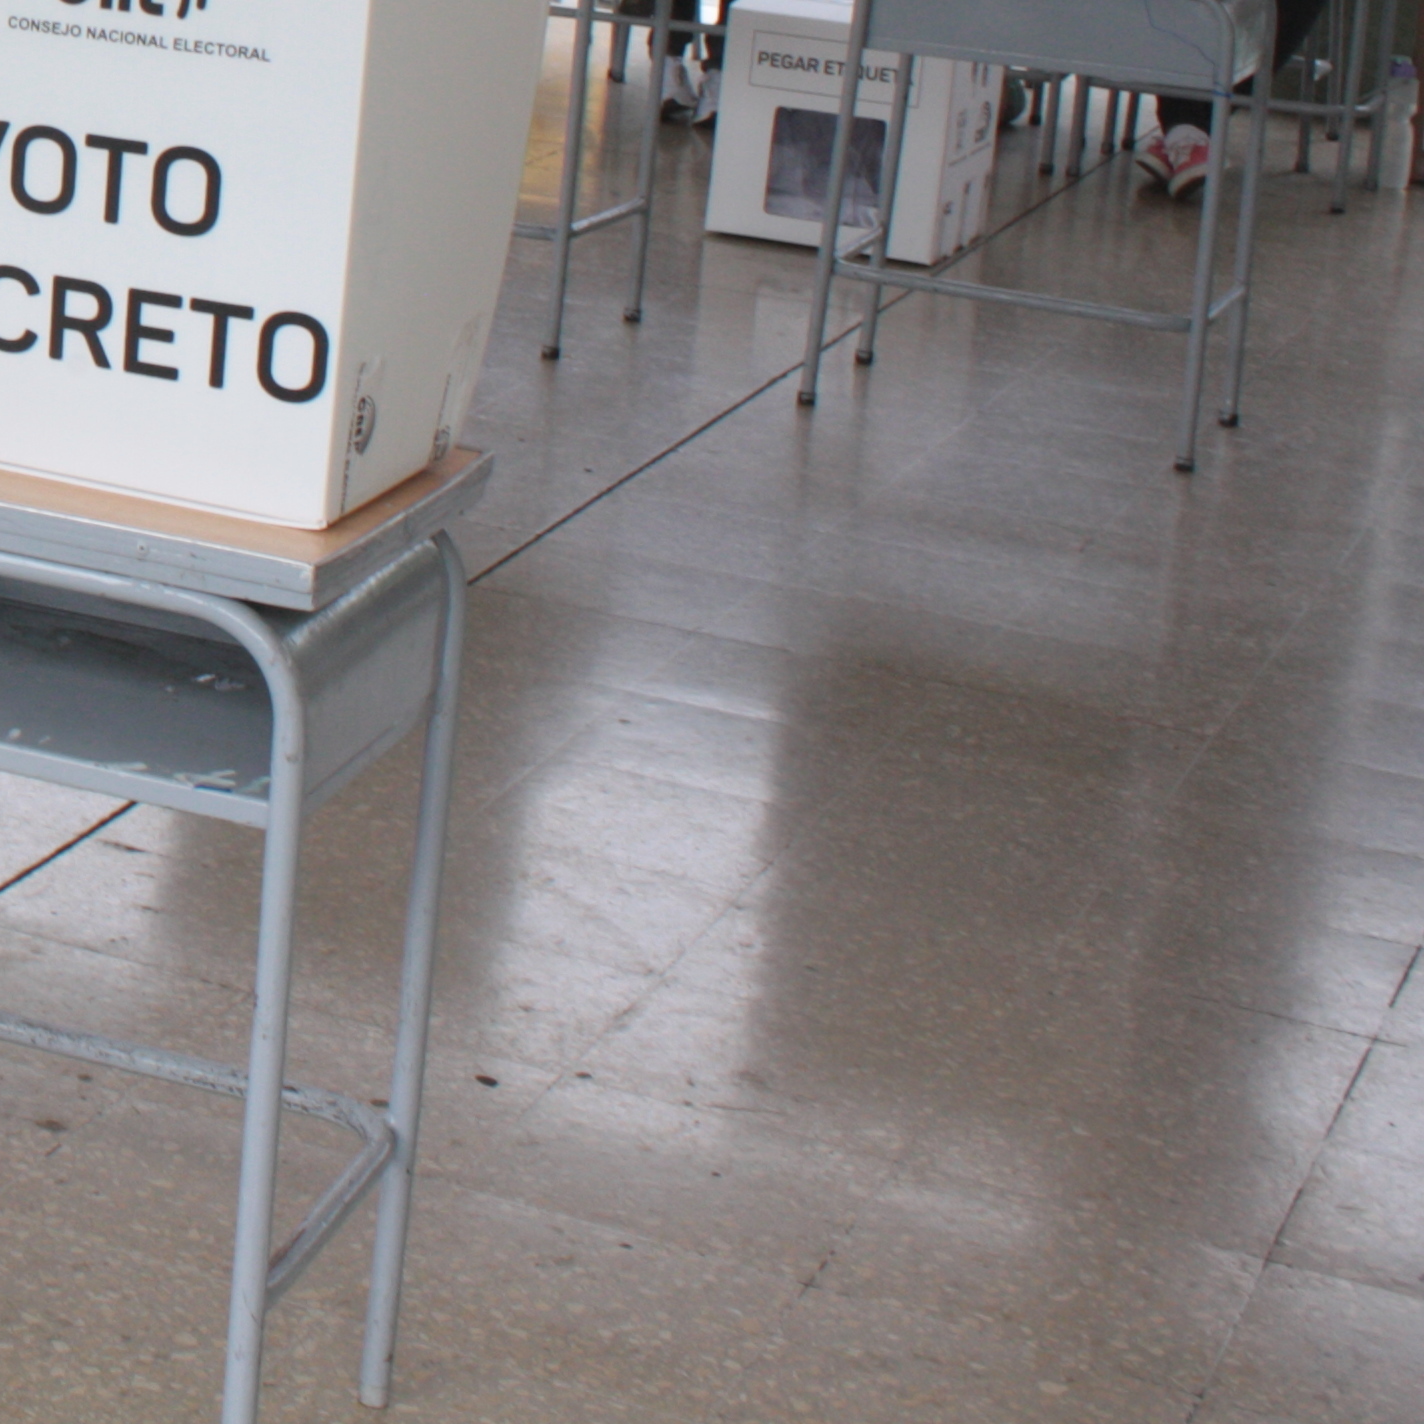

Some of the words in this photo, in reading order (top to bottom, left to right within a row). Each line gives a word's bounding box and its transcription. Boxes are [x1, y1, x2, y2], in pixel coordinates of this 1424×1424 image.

[8, 15, 83, 40] CONSEJO
[86, 25, 169, 50] NACIONAL
[172, 36, 272, 63] ELECTORAL
[757, 50, 820, 74] PEGAR
